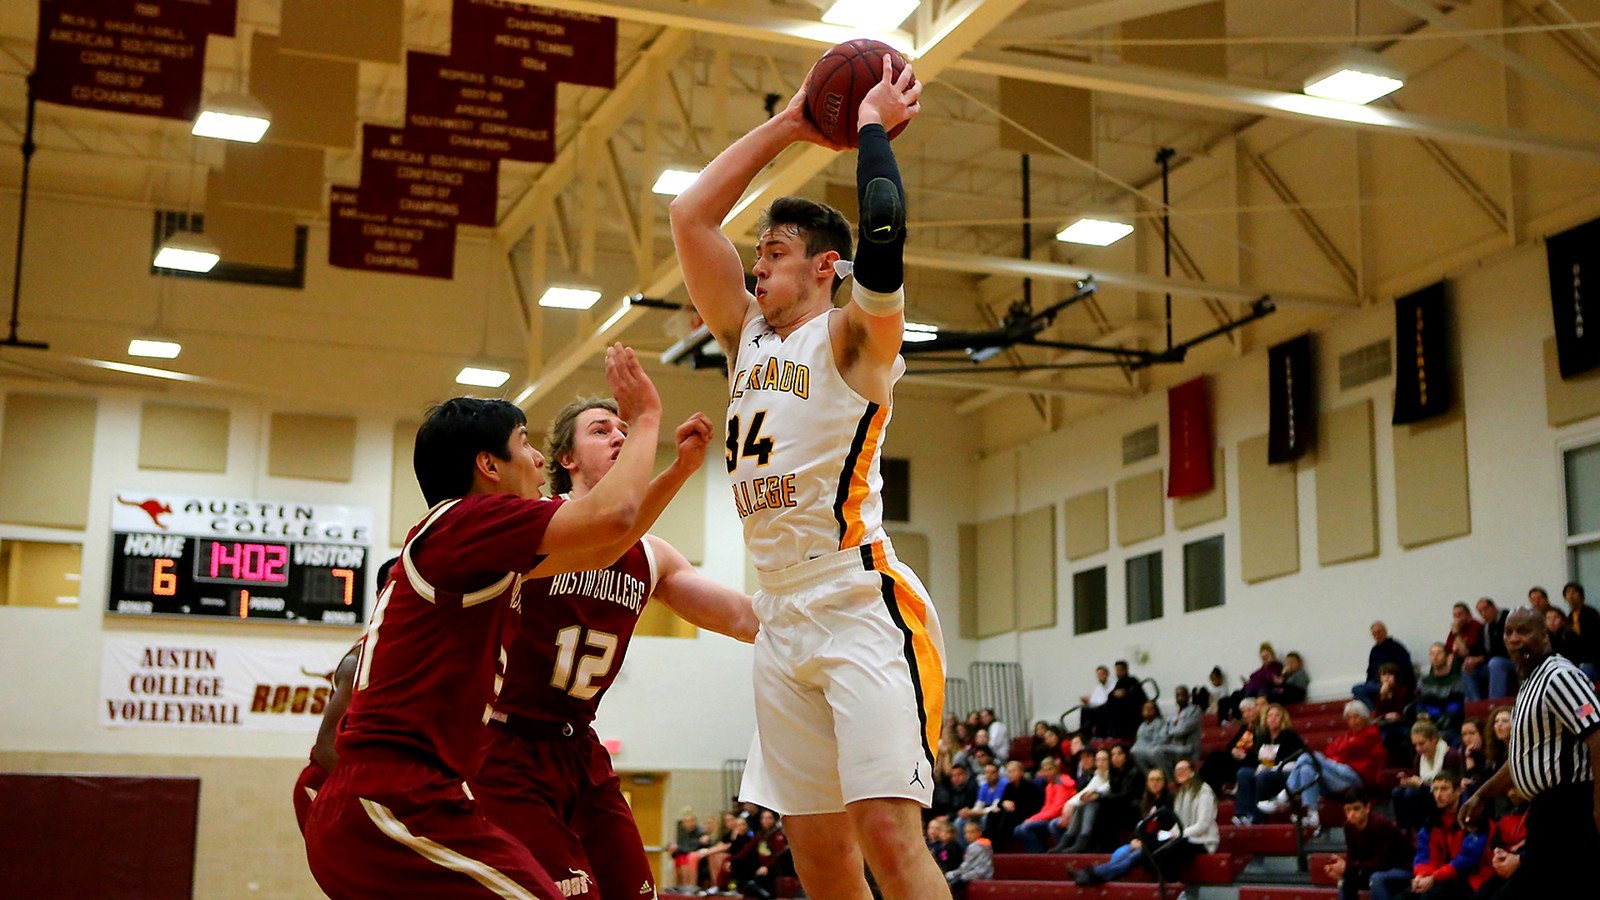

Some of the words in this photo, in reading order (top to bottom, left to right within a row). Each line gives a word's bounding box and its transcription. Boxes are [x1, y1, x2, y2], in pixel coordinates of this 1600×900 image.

[50, 29, 113, 47] AMERICAN
[80, 51, 161, 72] CONFERENCE
[184, 500, 313, 520] AUSTIN
[211, 518, 369, 541] COLLEGE
[124, 533, 186, 558] HOME
[294, 543, 365, 568] VISITOR
[152, 558, 177, 596] 6
[332, 568, 354, 606] 7
[141, 647, 217, 670] AUSTIN
[550, 624, 618, 700] 12
[130, 674, 223, 696] COLLEGE
[107, 700, 243, 725] VOLLEYBALL
[555, 876, 589, 898] OOS
